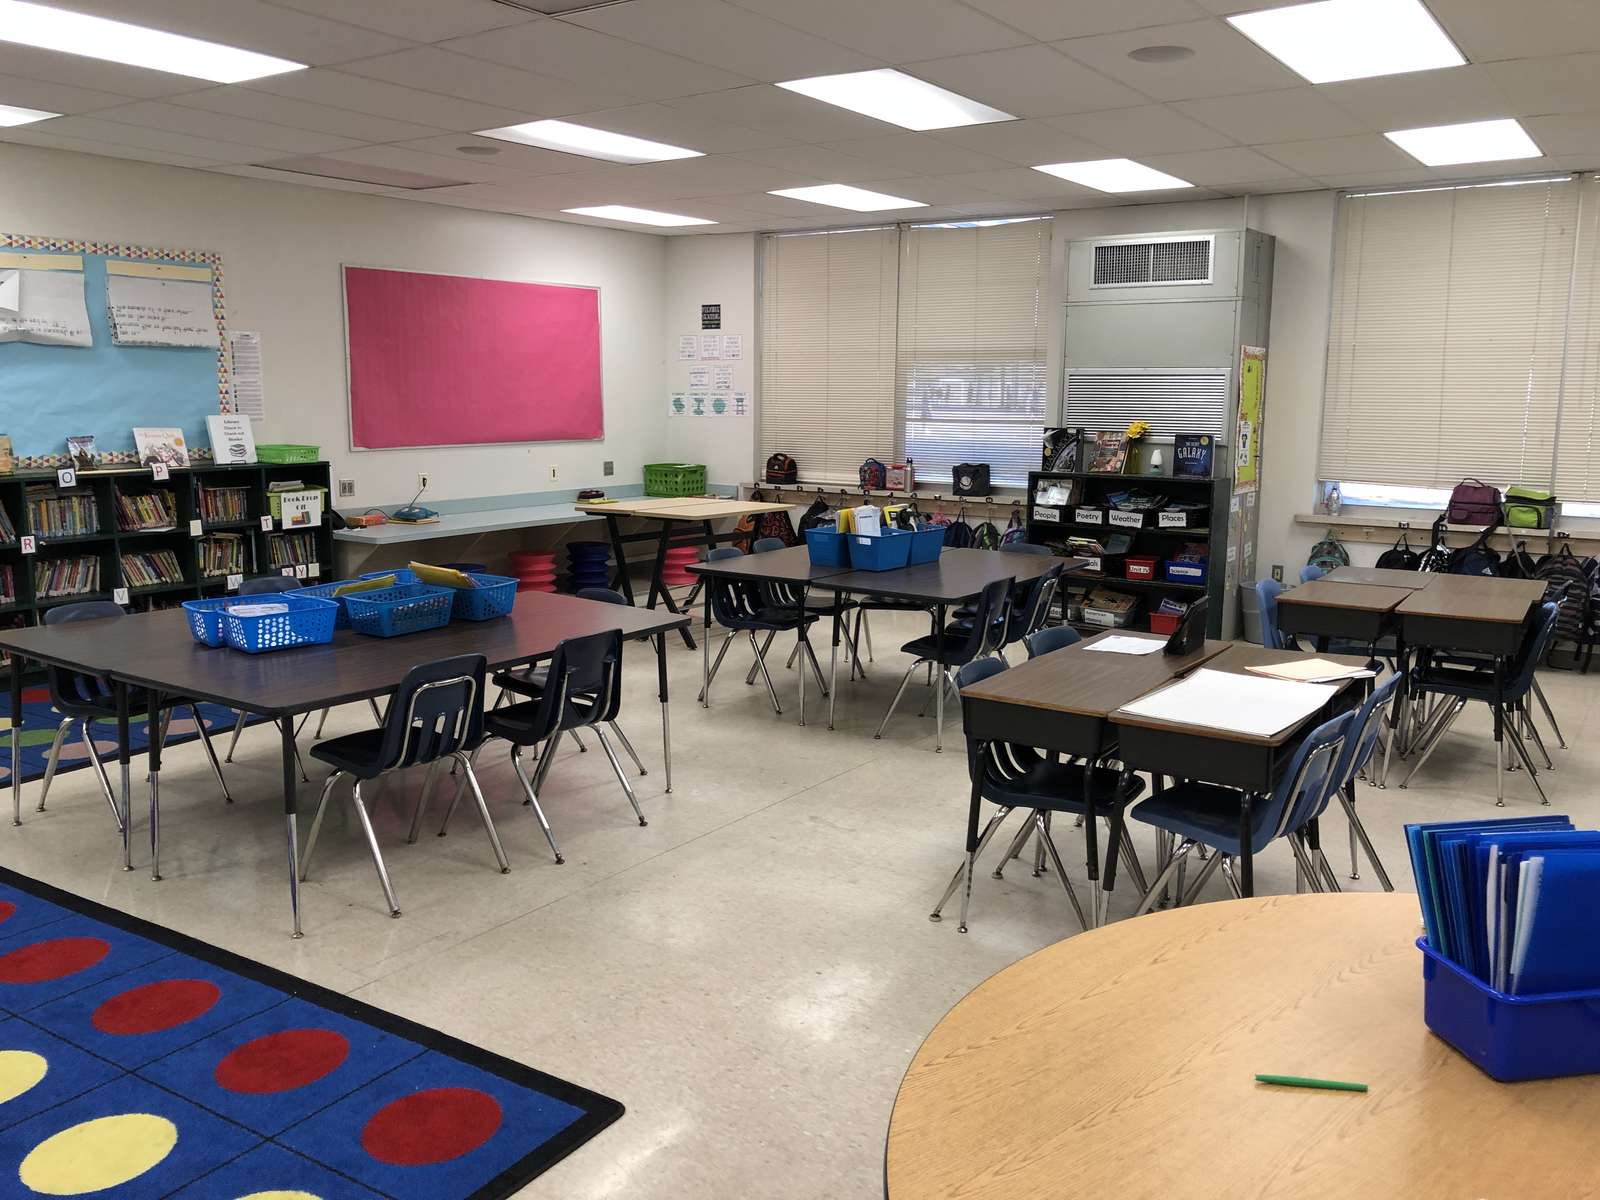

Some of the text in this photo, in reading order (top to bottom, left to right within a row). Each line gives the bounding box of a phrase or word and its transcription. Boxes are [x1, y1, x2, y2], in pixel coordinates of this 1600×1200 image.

[1177, 447, 1207, 460] GALAXY
[155, 465, 163, 477] P
[1034, 510, 1057, 520] People
[1076, 511, 1099, 521] Poetry
[1111, 513, 1140, 524] Weather
[1161, 514, 1184, 522] Places
[263, 518, 270, 529] T
[23, 537, 33, 550] R
[297, 566, 305, 577] Y
[115, 590, 125, 601] V
